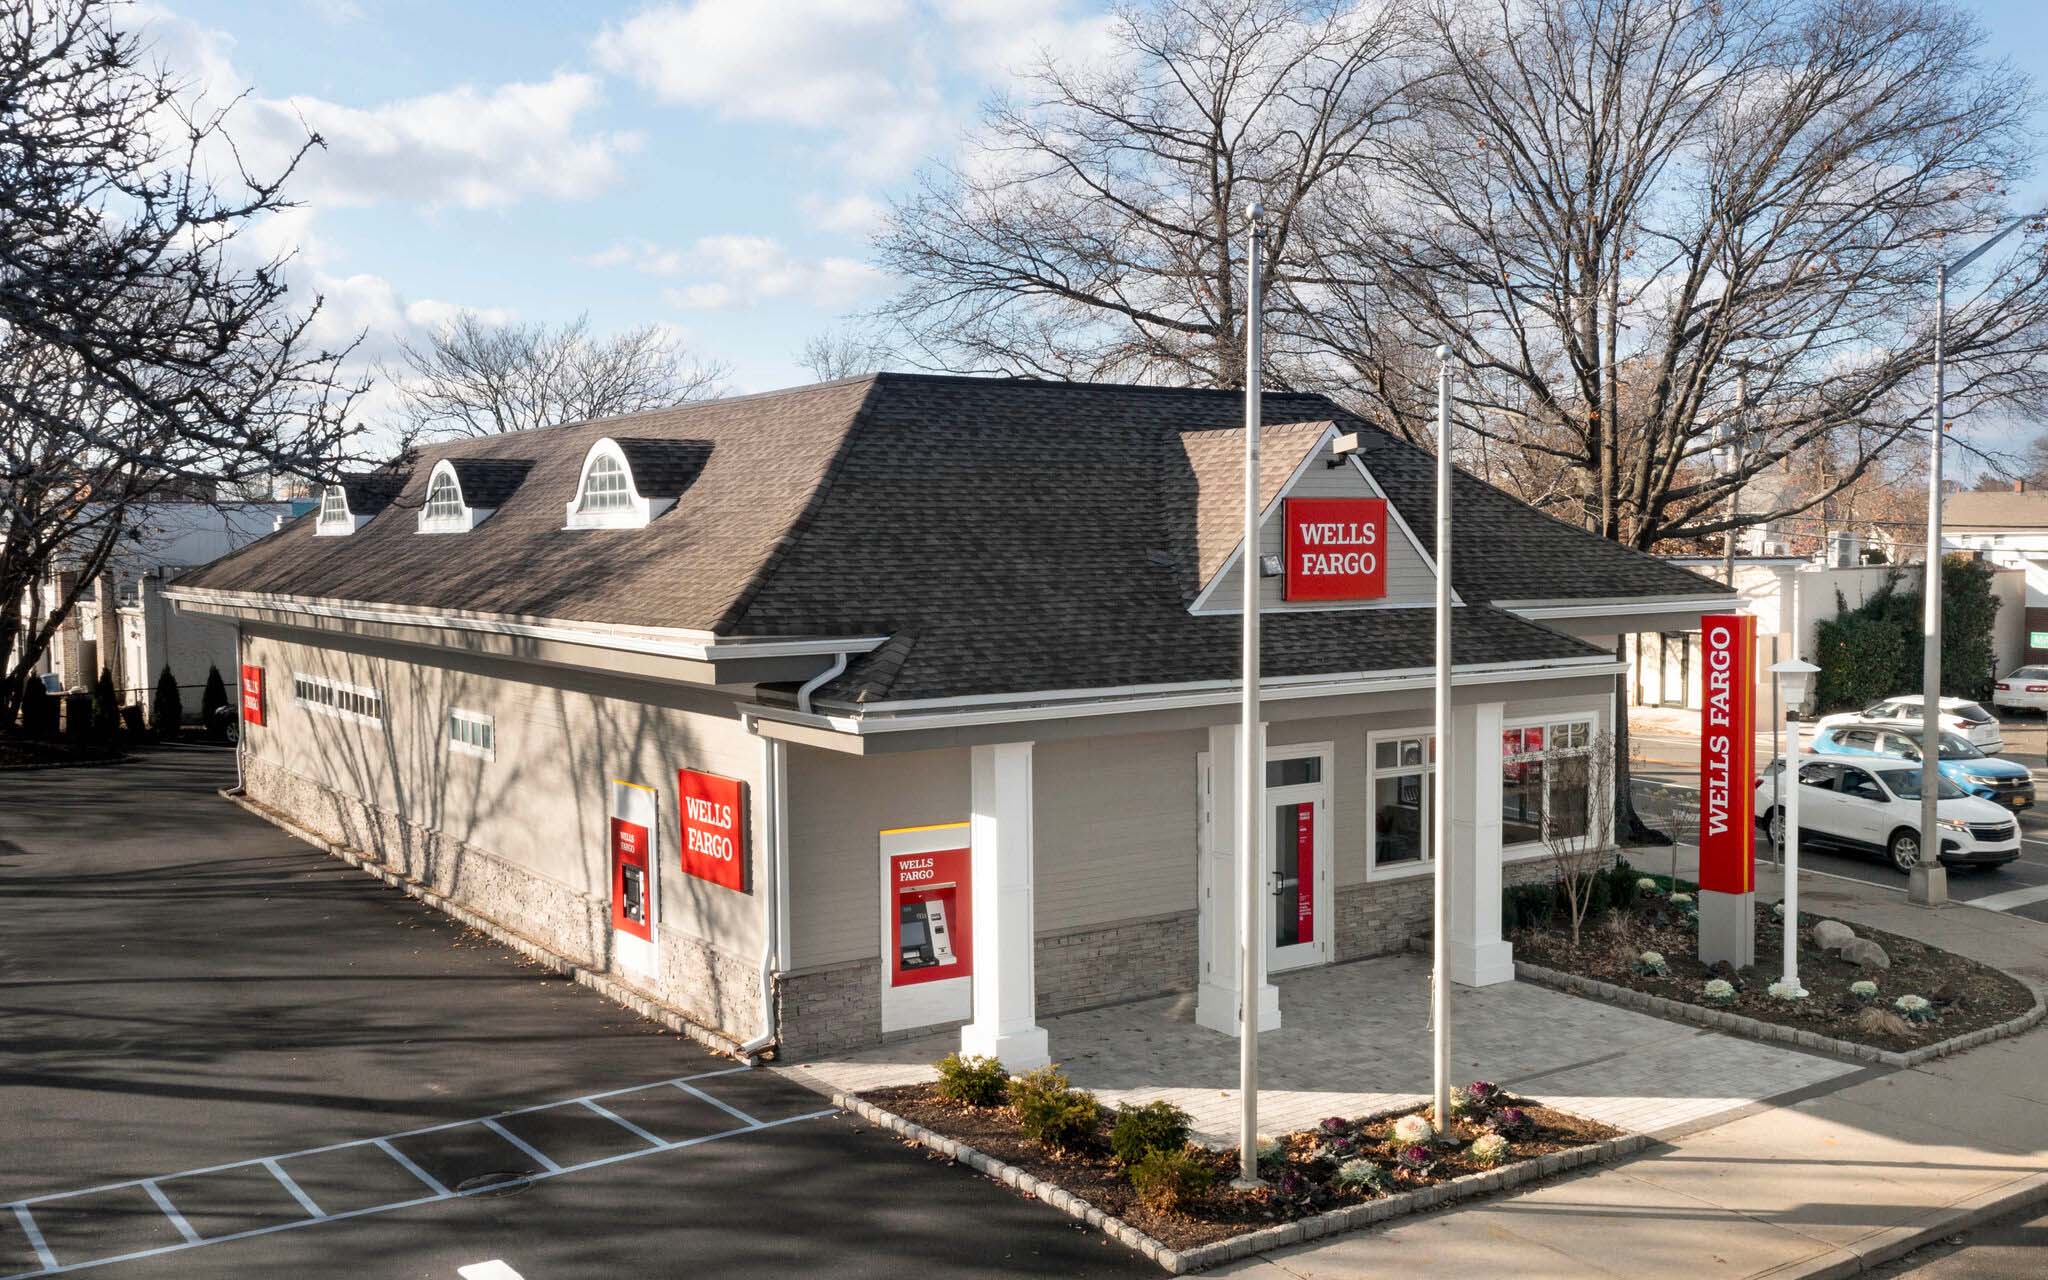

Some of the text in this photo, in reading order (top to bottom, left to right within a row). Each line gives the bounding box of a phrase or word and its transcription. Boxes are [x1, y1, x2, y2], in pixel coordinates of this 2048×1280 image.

[1300, 523, 1376, 545] WELLS
[1302, 553, 1376, 575] FARGO
[1708, 626, 1731, 836] WELLS FARGO
[685, 796, 732, 829] WELLS
[688, 828, 733, 862] FARGO
[899, 858, 933, 870] WELLS
[900, 869, 934, 882] FARGO
